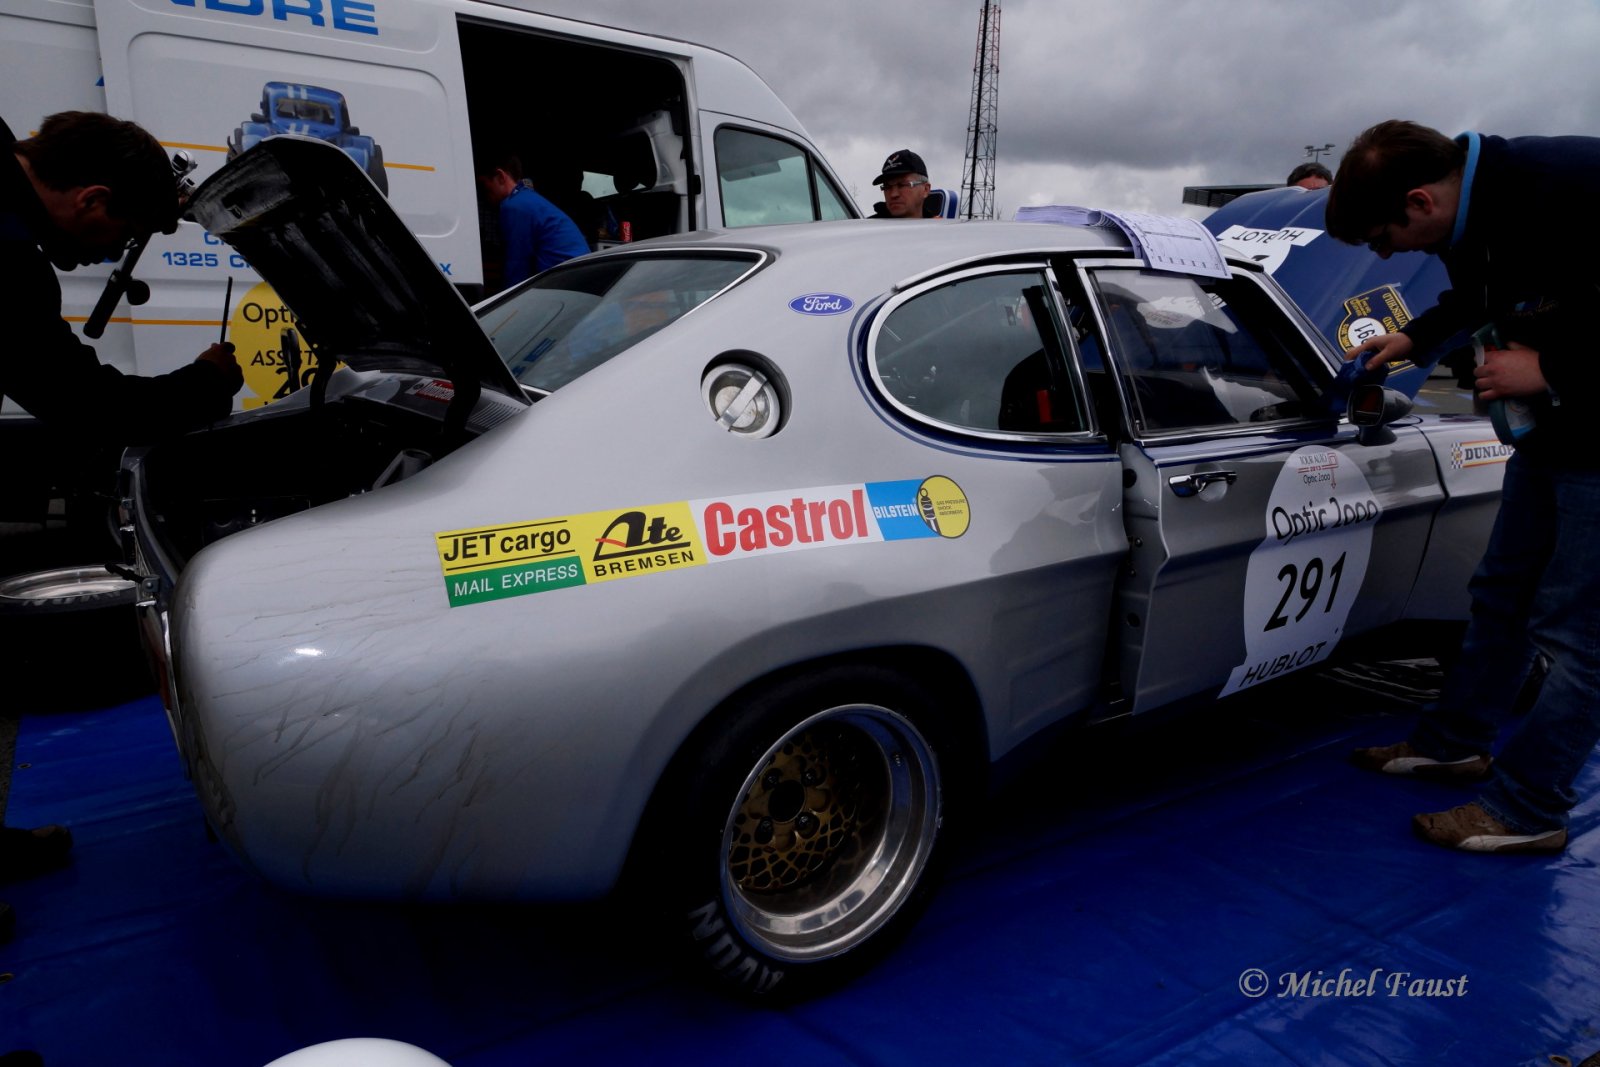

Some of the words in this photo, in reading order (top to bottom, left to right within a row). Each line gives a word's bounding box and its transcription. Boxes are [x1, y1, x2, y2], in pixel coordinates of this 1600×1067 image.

[162, 252, 219, 267] 1325
[803, 296, 842, 311] Ford
[1382, 292, 1409, 330] OTHSCHILD
[704, 489, 869, 556] Castrol
[874, 503, 919, 519] BILSTEIN
[1272, 501, 1327, 545] Optic
[1329, 497, 1378, 528] 2000
[443, 533, 496, 562] JET
[500, 528, 571, 553] cargo
[593, 511, 684, 561] Ate
[454, 578, 494, 597] MAIL
[501, 564, 578, 589] EXPRESS
[593, 550, 694, 577] BREMSEN
[1263, 551, 1347, 632] 291
[1239, 641, 1327, 687] HUBLOT
